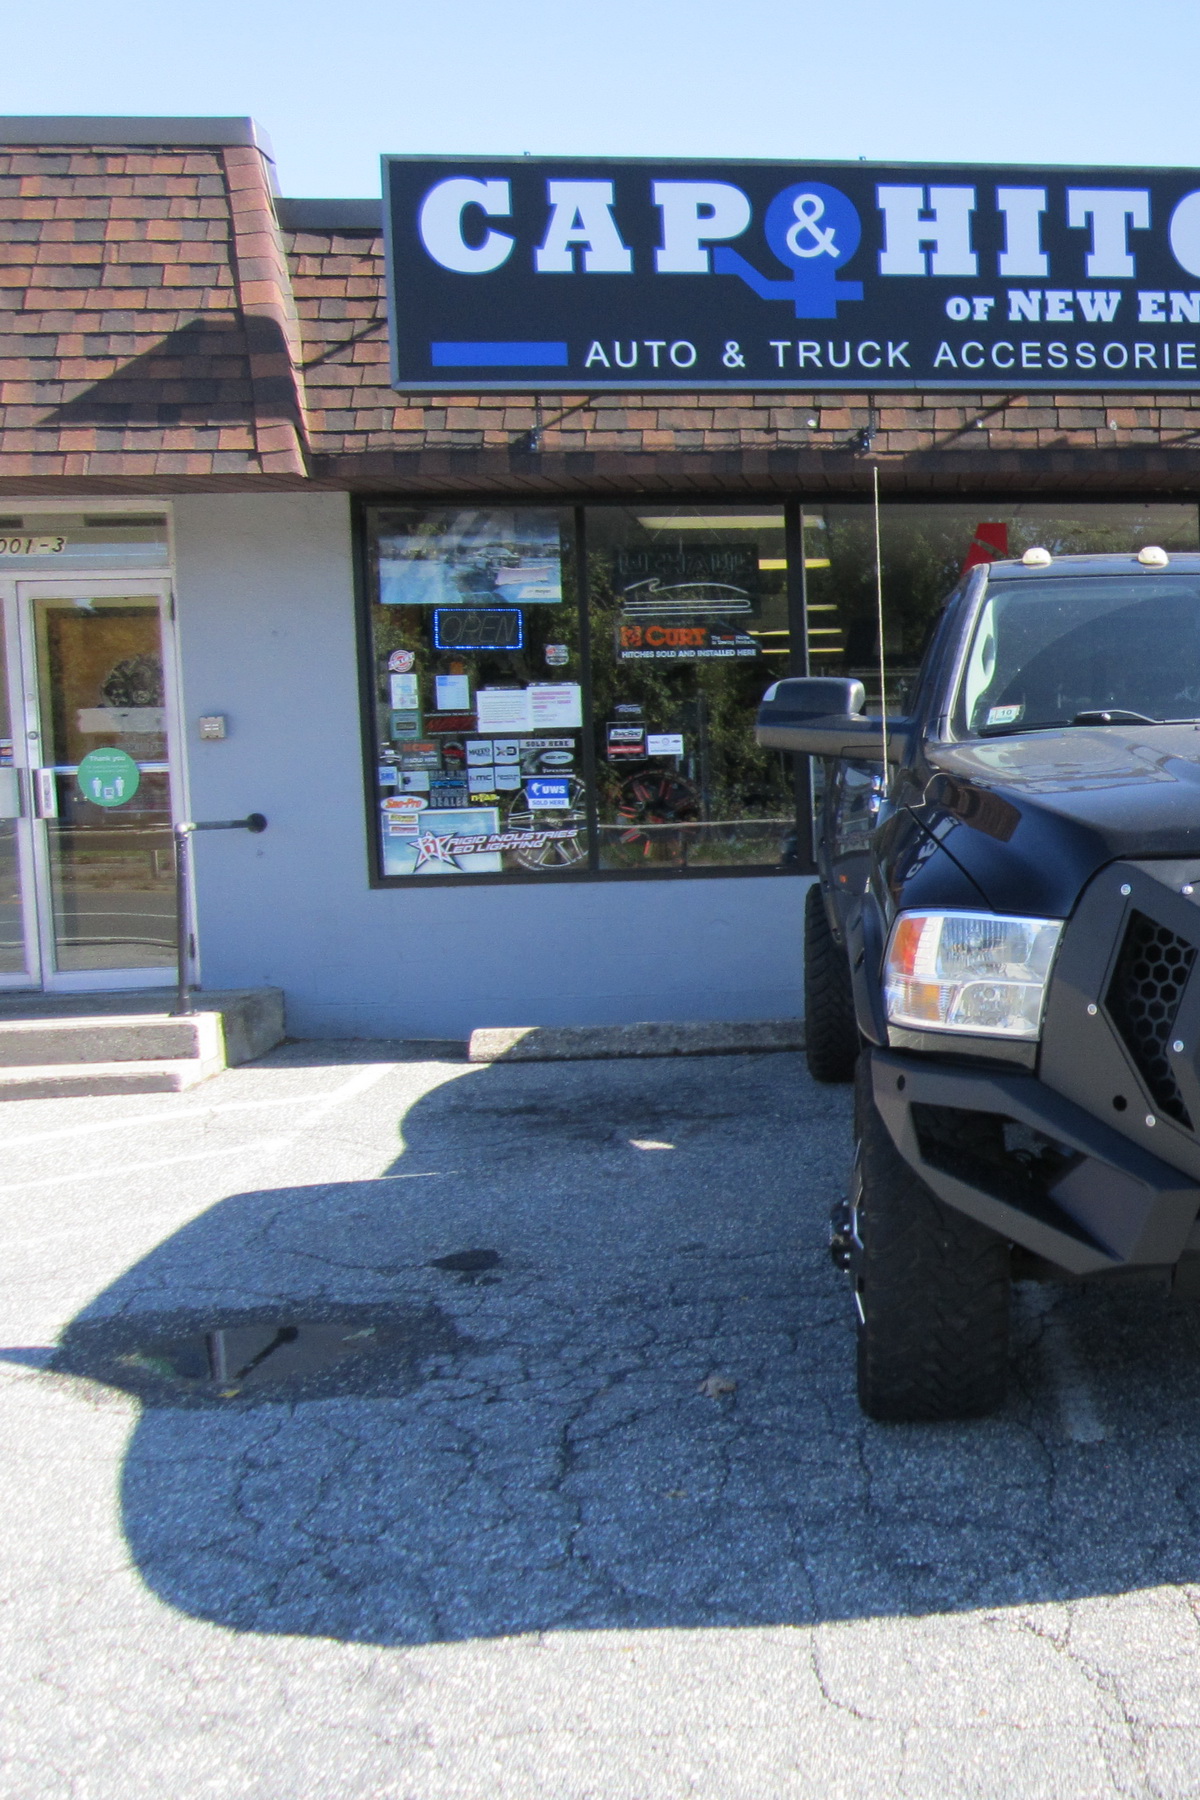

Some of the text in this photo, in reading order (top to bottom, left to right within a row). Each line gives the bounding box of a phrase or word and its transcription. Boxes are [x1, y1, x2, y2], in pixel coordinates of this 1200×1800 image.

[417, 176, 753, 275] CAP
[785, 193, 841, 259] &
[945, 296, 995, 321] OF
[1007, 290, 1122, 323] NEW
[584, 340, 698, 369] AUTO
[722, 341, 746, 369] &
[769, 340, 911, 368] TRUCK
[441, 616, 515, 642] OPEN
[697, 649, 736, 657] INSTALLED
[737, 648, 757, 656] HERE
[542, 785, 566, 794] UWS
[450, 830, 579, 846] RIGID INDUSTRIES
[476, 841, 544, 852] LIGHTING
